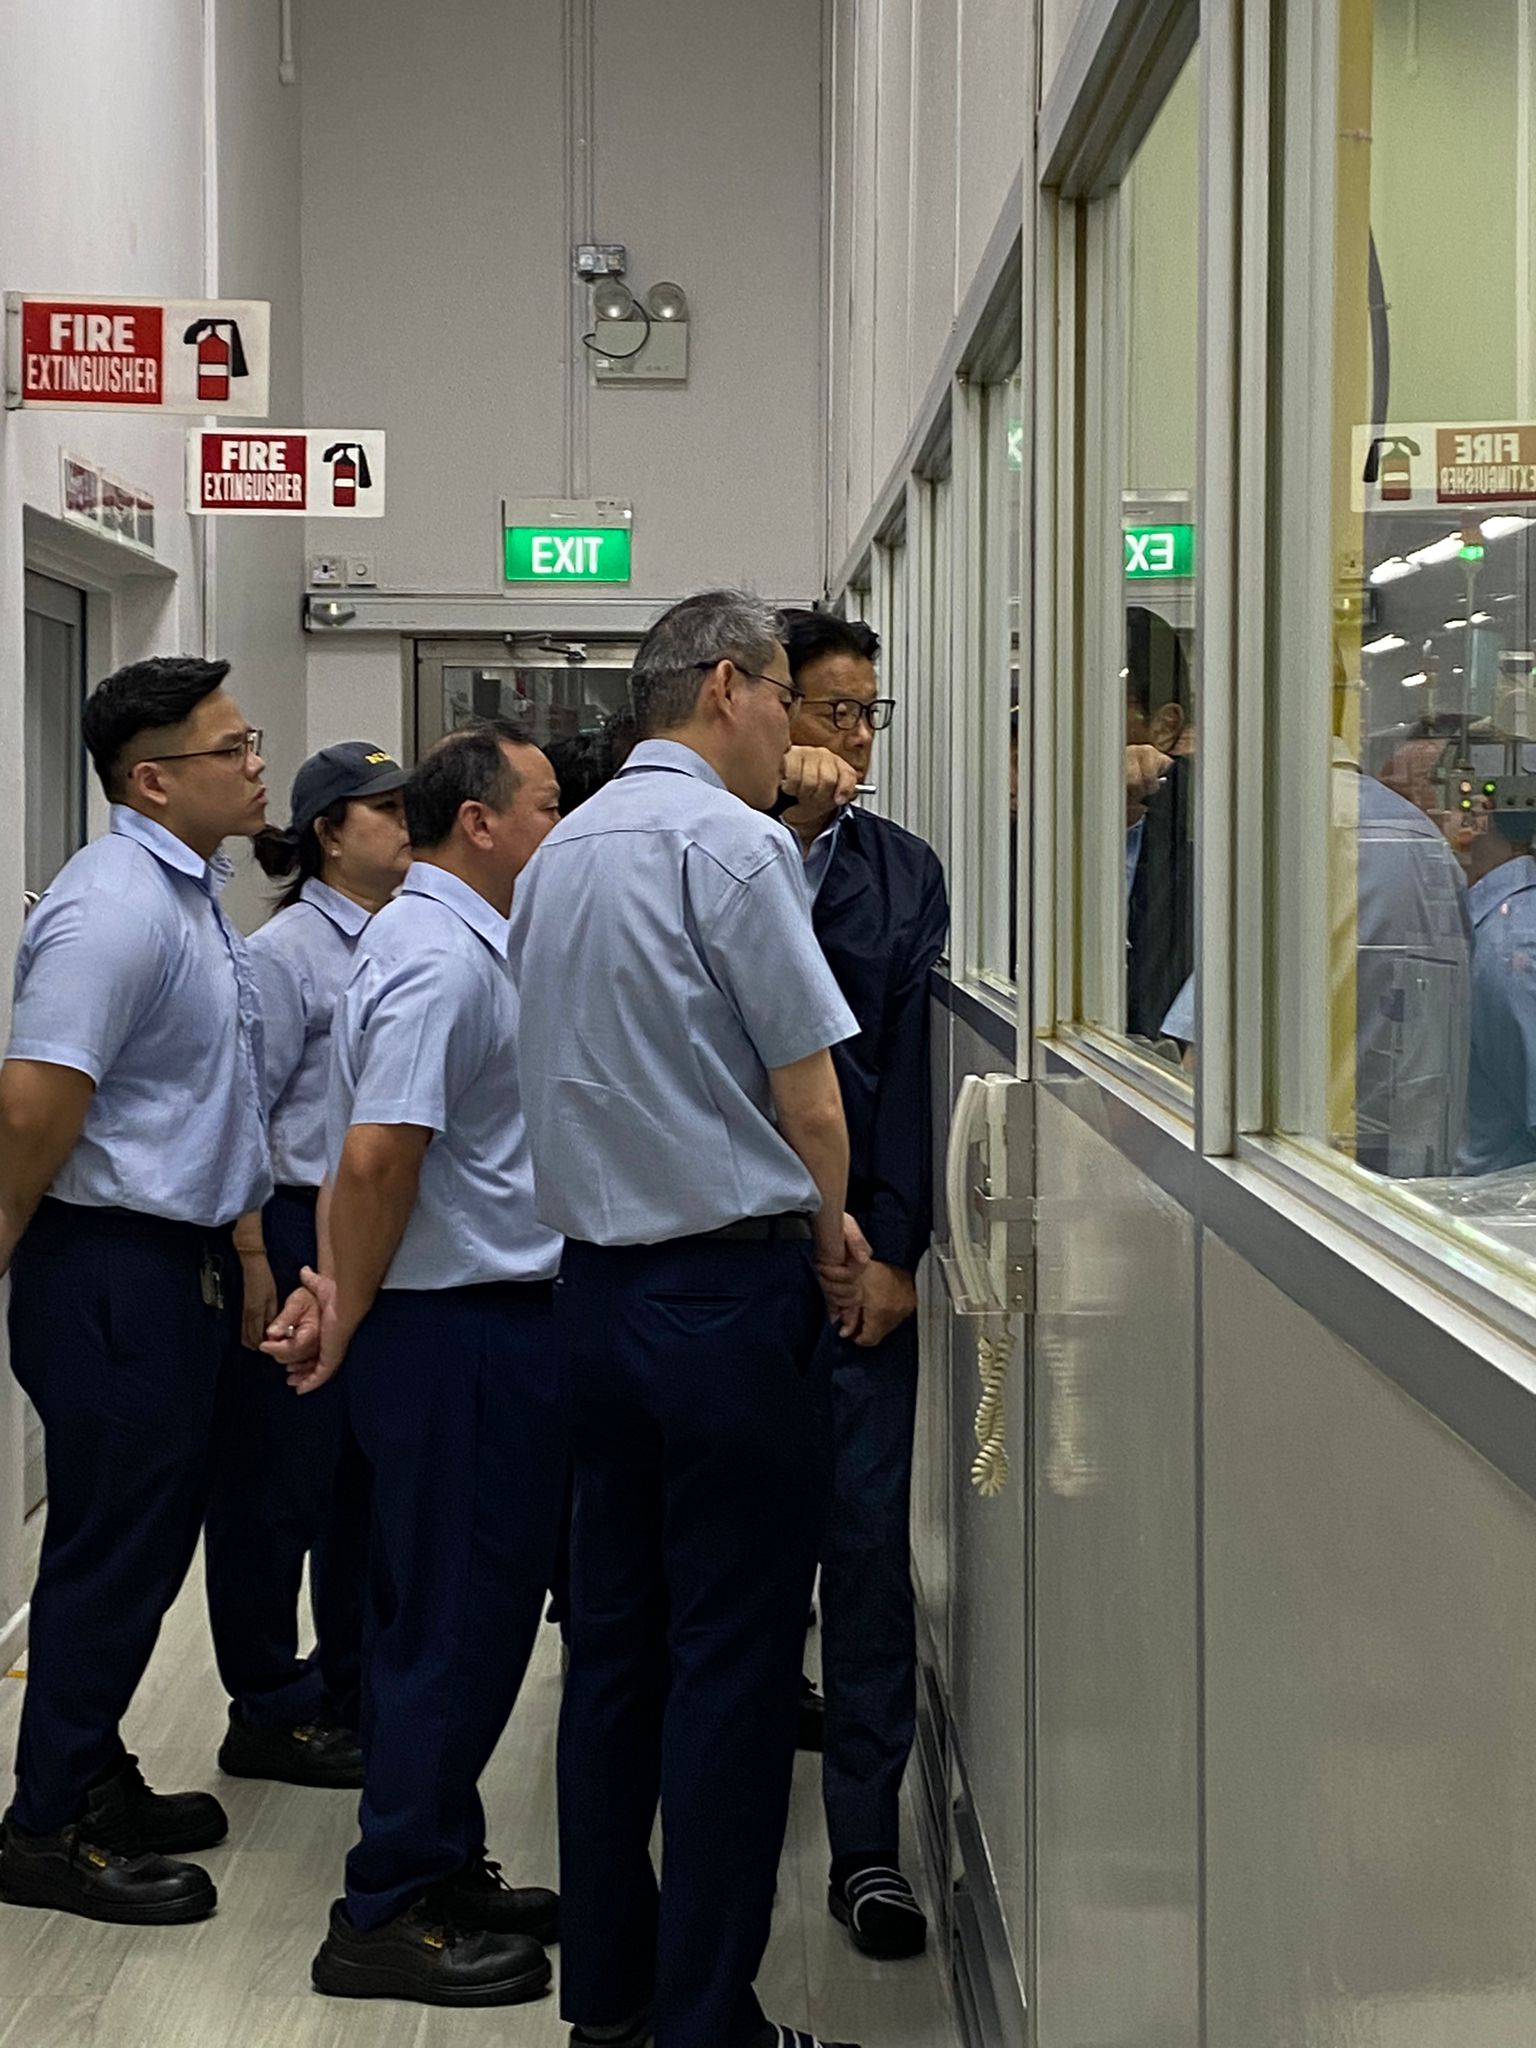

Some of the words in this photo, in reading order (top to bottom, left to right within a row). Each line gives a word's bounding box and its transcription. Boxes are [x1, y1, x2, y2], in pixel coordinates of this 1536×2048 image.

[50, 312, 136, 353] FIRE
[26, 353, 158, 394] EXTINGUISHER
[221, 440, 287, 471] FIRE
[204, 472, 303, 502] EXTINGUISHER
[531, 536, 604, 574] EXIT
